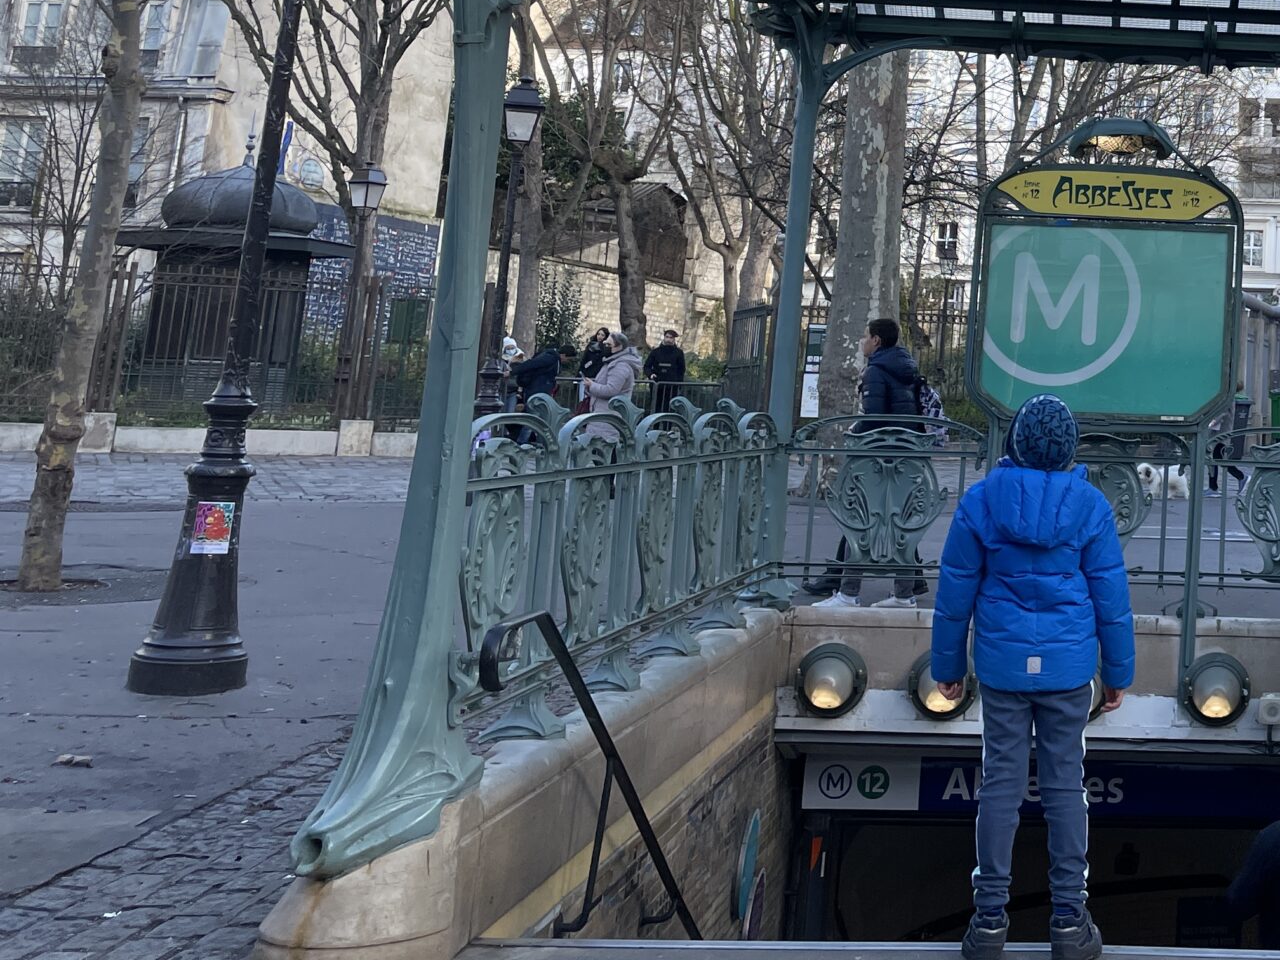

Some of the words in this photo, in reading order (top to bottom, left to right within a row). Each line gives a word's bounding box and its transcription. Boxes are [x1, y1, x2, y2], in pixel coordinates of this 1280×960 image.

[1030, 189, 1040, 199] 12
[1190, 197, 1200, 208] 12
[1010, 251, 1100, 345] M
[860, 772, 886, 793] 12
[941, 766, 1124, 804] Aees
